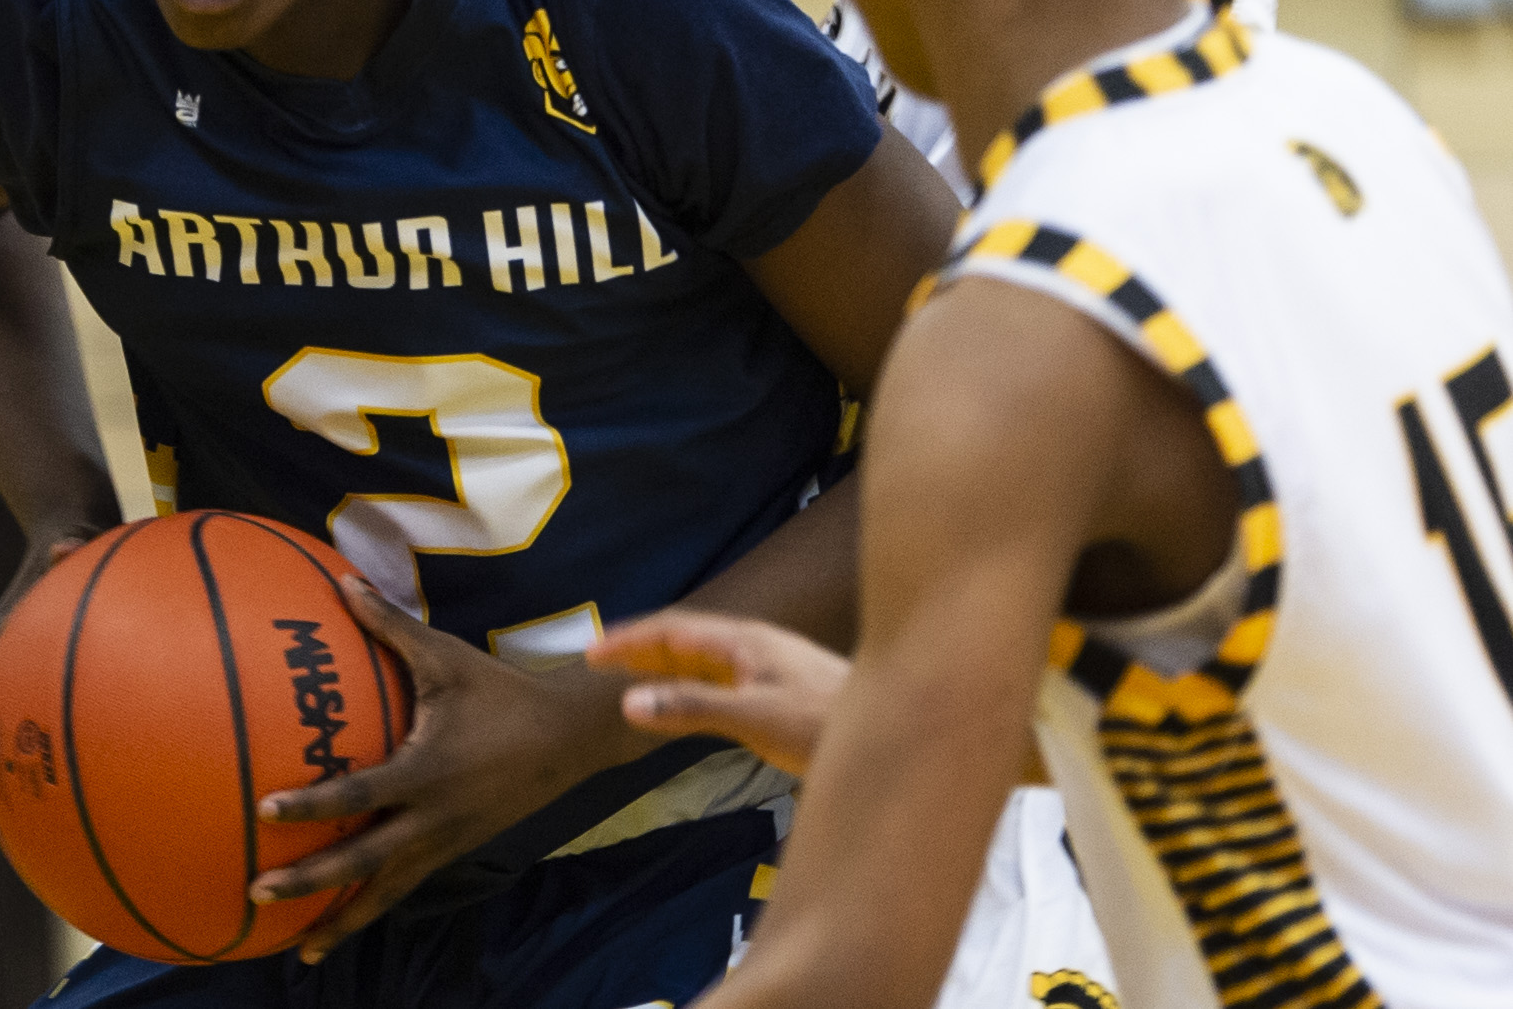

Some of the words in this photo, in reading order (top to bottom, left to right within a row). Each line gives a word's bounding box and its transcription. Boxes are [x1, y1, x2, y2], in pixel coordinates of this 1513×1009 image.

[110, 199, 463, 290] ARTHUR
[482, 199, 679, 293] HILL
[261, 345, 604, 674] 2
[272, 618, 350, 788] MHSAA
